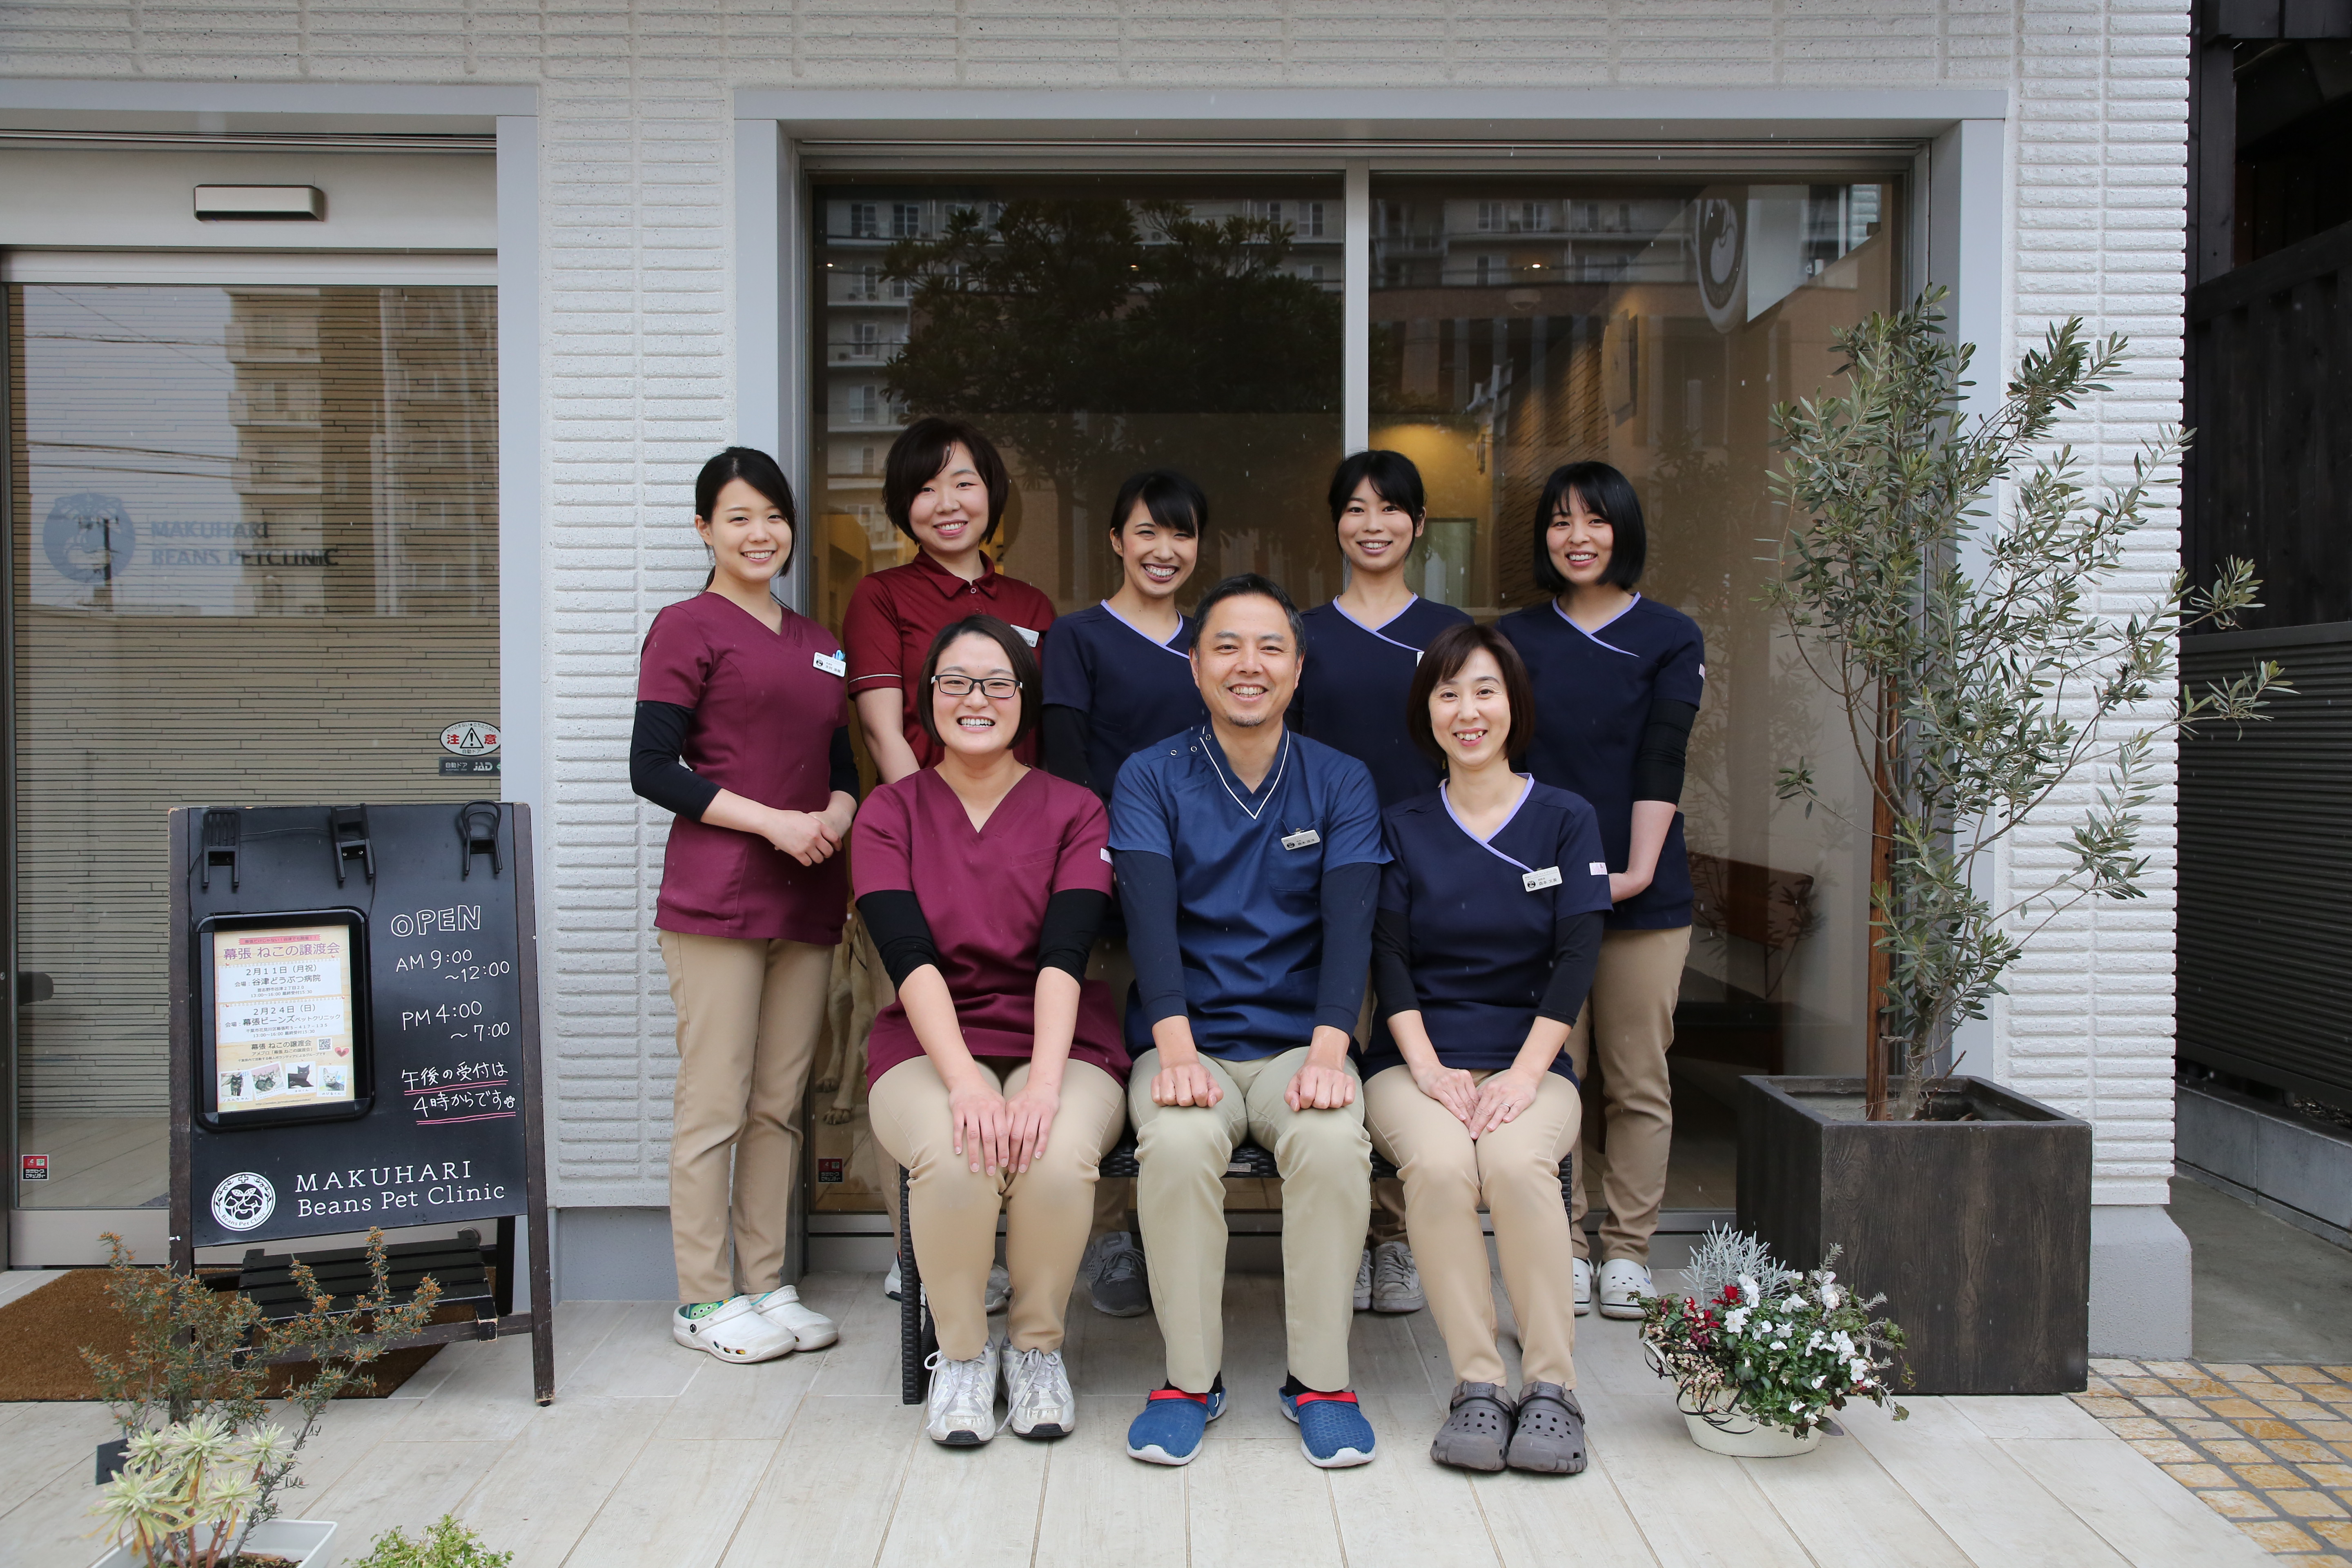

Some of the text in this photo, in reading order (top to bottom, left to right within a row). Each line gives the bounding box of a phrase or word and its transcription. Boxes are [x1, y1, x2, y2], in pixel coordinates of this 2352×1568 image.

[151, 521, 269, 538] MAKUHARI
[151, 550, 220, 565] BEANS
[447, 734, 497, 744] 注 意
[391, 904, 481, 937] OPEN
[223, 942, 341, 960] 幕張 ねこの譲渡会
[396, 949, 472, 972] AM 9:00
[402, 1000, 482, 1031] PM 4:00
[268, 1040, 312, 1049] ねこの譲渡会
[401, 1061, 508, 1090] 午後の受付は
[413, 1088, 502, 1118] 4時からです
[295, 1160, 472, 1192] MAKUHARI
[298, 1183, 506, 1218] Beans Pet Clinic
[221, 1214, 238, 1226] Beans
[250, 1212, 267, 1224] Clinic
